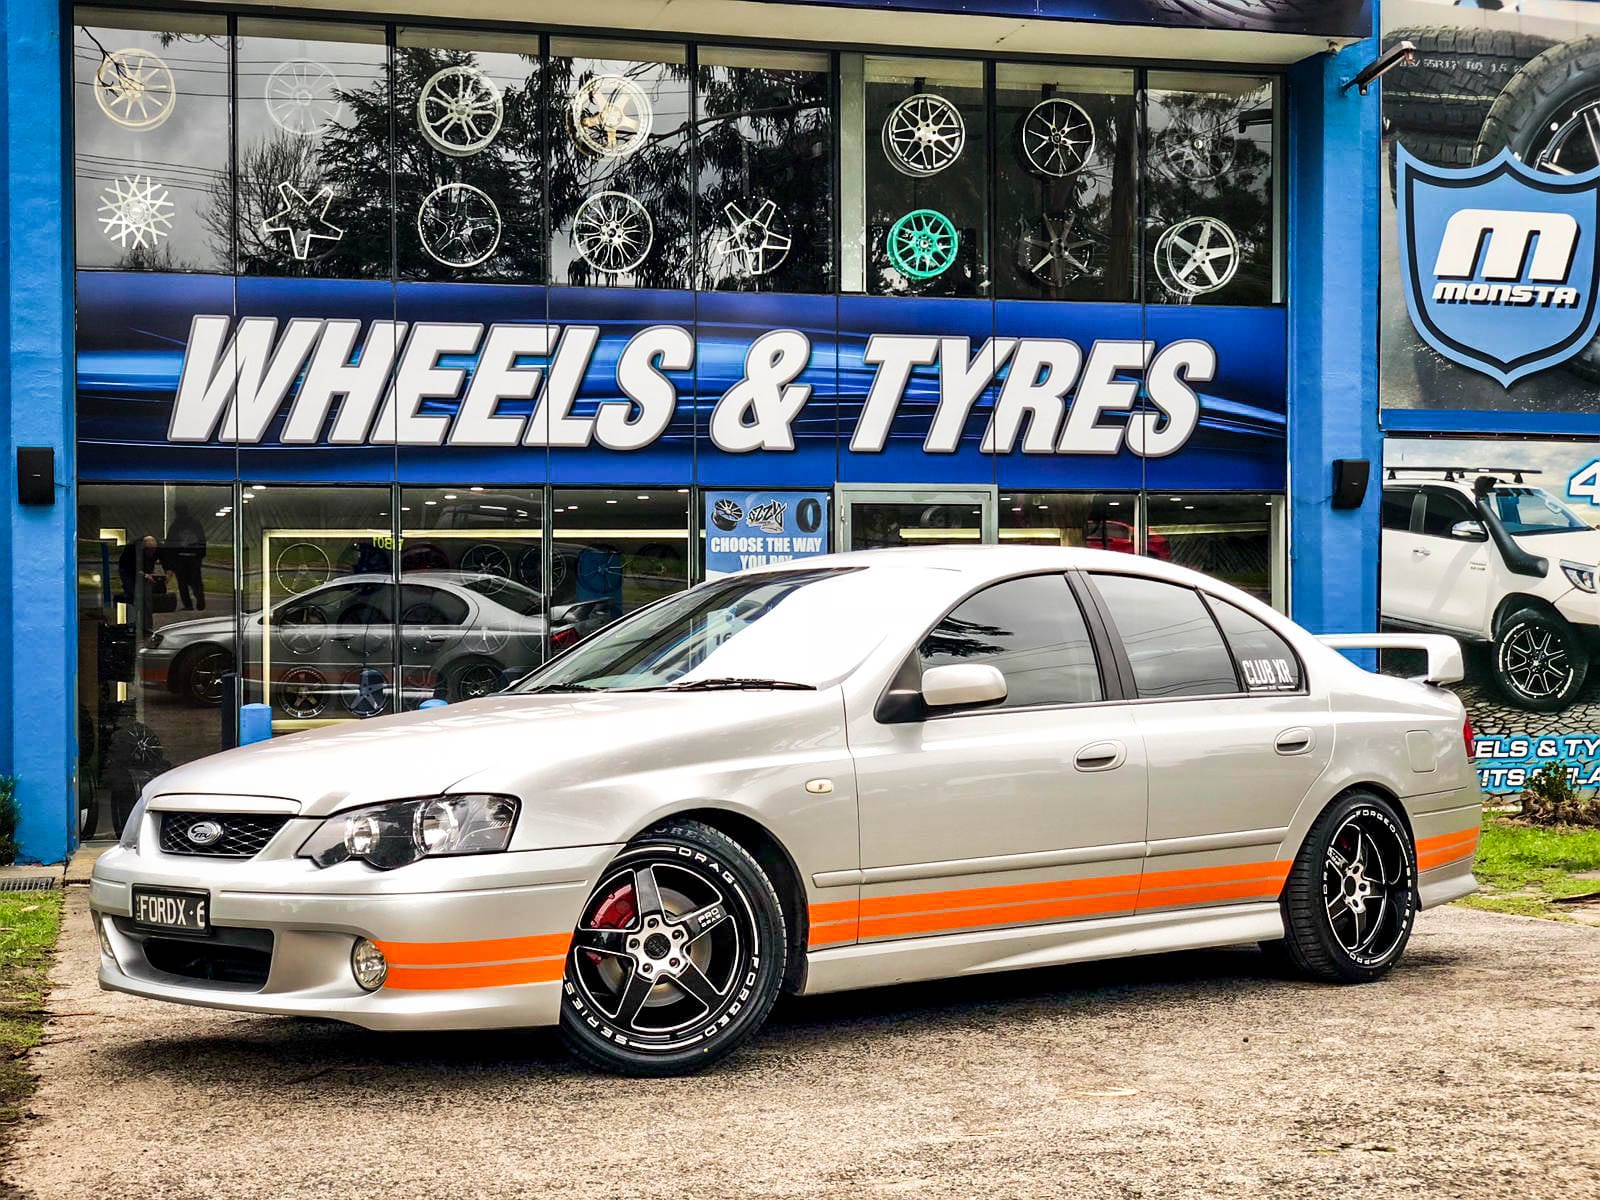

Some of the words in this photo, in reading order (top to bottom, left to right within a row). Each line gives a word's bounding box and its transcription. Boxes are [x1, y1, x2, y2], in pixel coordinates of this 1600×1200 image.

[1431, 282, 1581, 309] MONSTA
[167, 314, 695, 452] WHEELS
[709, 329, 812, 453] &
[848, 333, 1217, 457] TYRES
[711, 537, 763, 553] CHOOSE
[767, 537, 791, 553] THE
[792, 537, 823, 553] WAY
[1242, 659, 1275, 685] CLUB
[1271, 658, 1293, 683] XR
[1474, 740, 1528, 758] ELS
[1536, 739, 1558, 757] &
[1477, 768, 1525, 787] ITS
[678, 846, 735, 885] DRAG
[140, 895, 187, 926] FORDX
[697, 907, 719, 924] PRO
[704, 956, 760, 1037] FORGED
[564, 981, 628, 1045] SERIES
